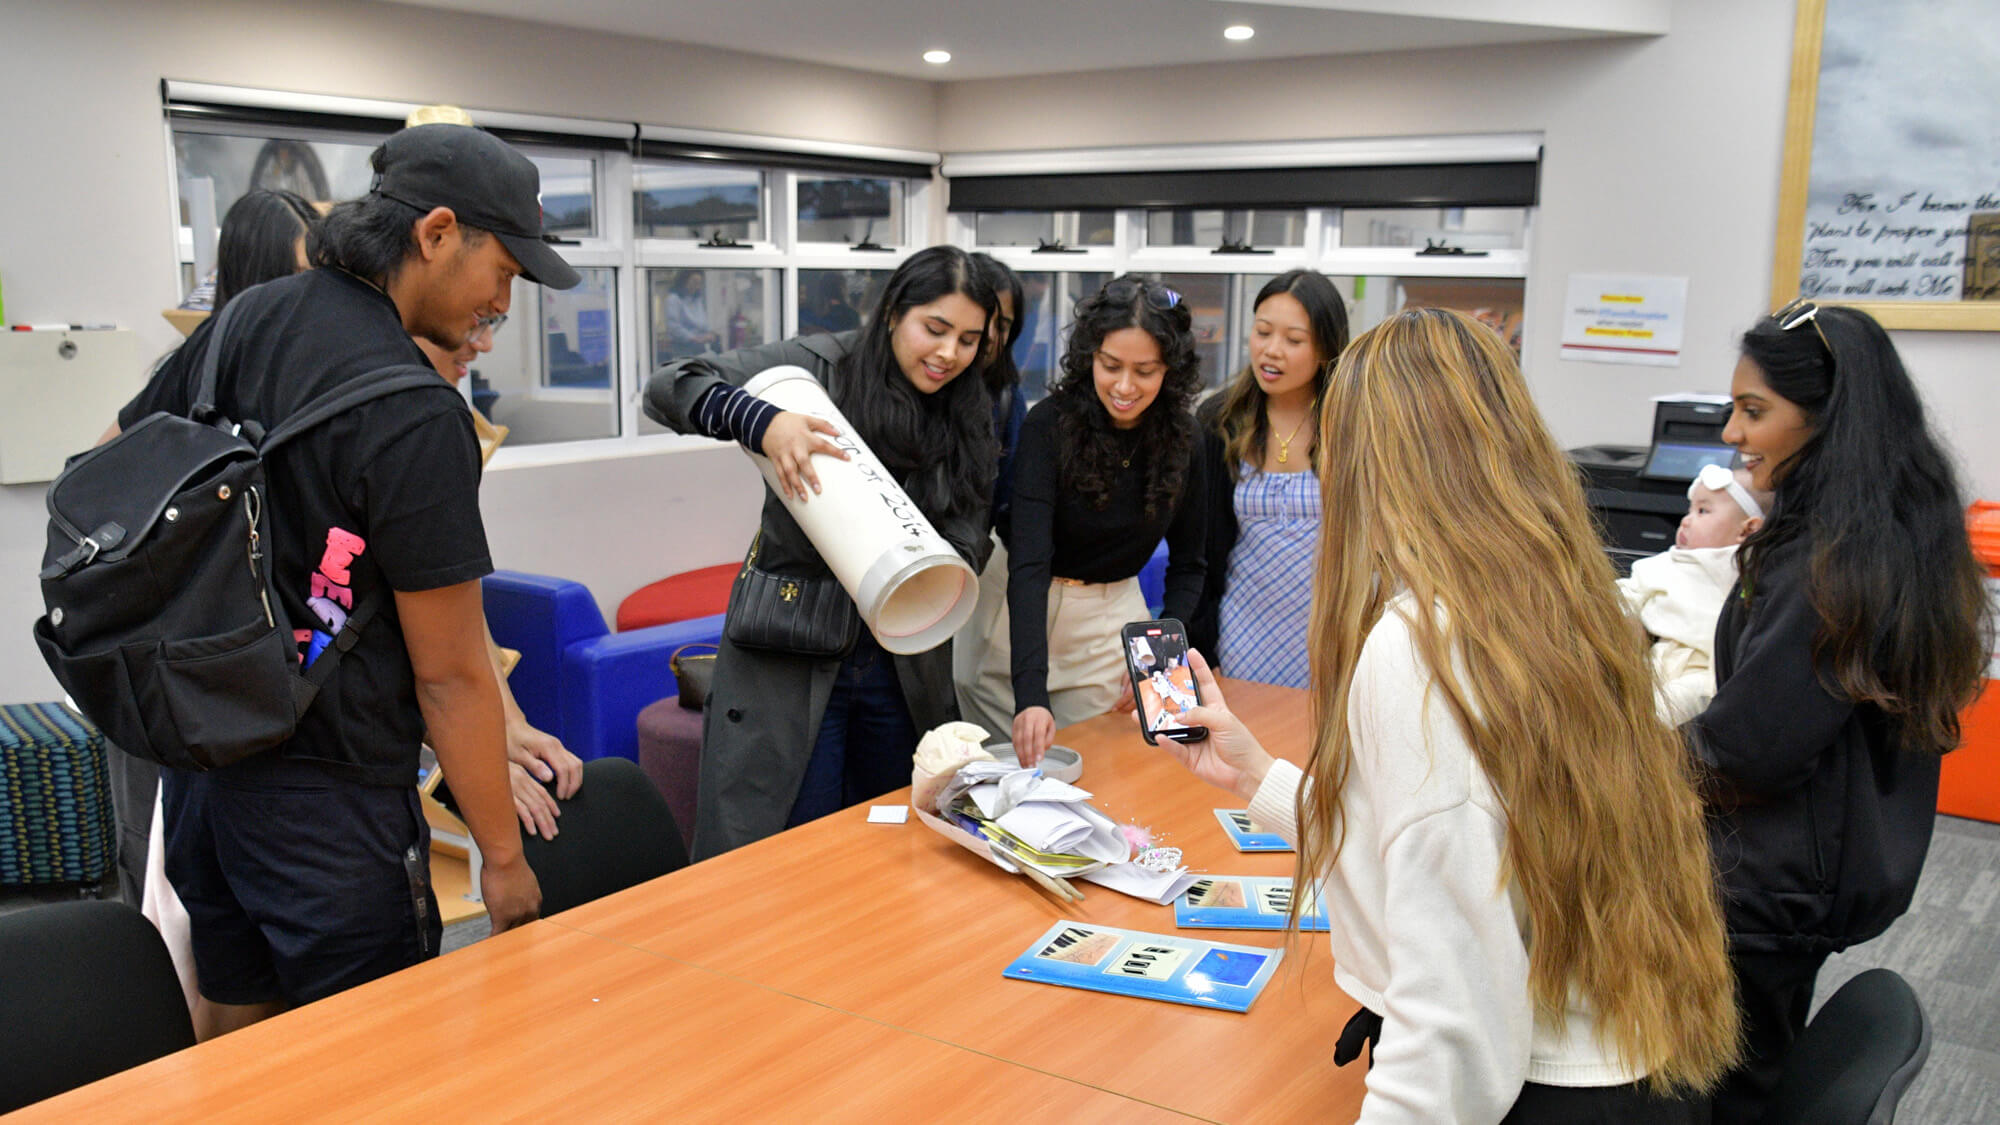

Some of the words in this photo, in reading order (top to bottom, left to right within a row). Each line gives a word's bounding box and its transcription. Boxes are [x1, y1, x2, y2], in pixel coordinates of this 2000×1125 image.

[1919, 193, 1968, 212] know
[1856, 219, 1873, 239] to
[1848, 257, 1882, 275] you
[1885, 252, 1920, 268] will
[1921, 251, 1954, 267] call
[1843, 278, 1877, 295] will
[879, 493, 928, 538] 2014
